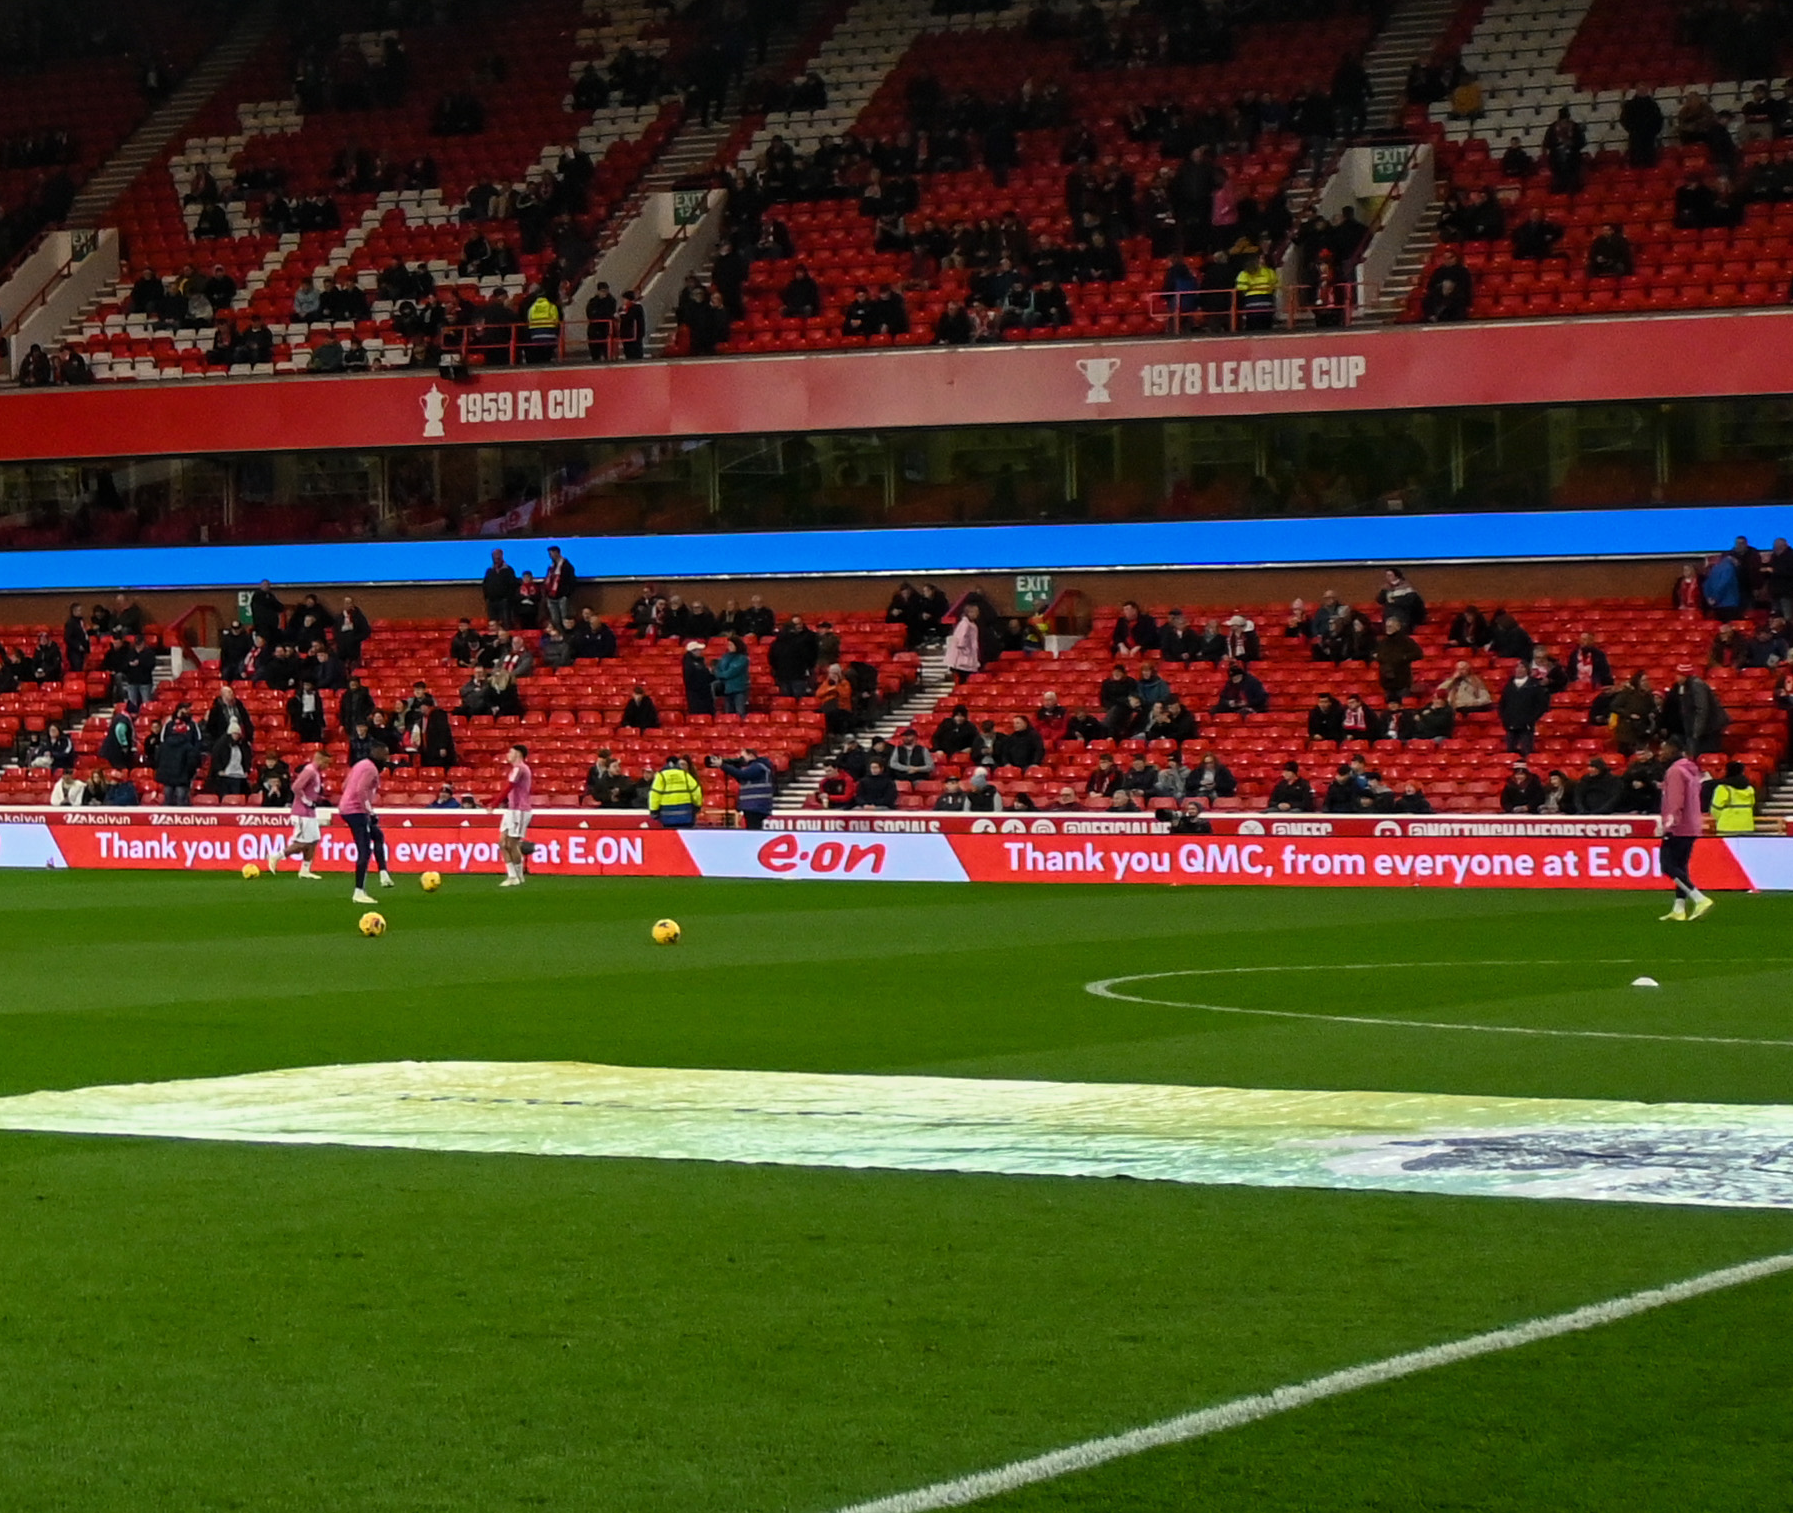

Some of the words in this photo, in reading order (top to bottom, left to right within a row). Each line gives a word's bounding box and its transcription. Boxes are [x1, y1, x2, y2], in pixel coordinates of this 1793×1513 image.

[1373, 148, 1407, 163] EXIT
[1141, 362, 1202, 396] 1978
[1208, 358, 1307, 394] LEAGUE
[1312, 355, 1366, 390] CUP
[457, 391, 513, 423] 1959
[518, 390, 543, 420] FA
[548, 388, 594, 419] CUP
[1016, 575, 1051, 591] EXIT
[95, 832, 177, 860] Thank
[182, 840, 230, 868] you
[533, 839, 561, 864] at
[568, 836, 643, 865] E.ON
[1004, 841, 1105, 873] Thank
[1111, 849, 1171, 881] you
[1178, 841, 1273, 879] QMC,
[1281, 844, 1366, 877] from
[1374, 850, 1535, 885] everyone
[1542, 849, 1579, 878] at
